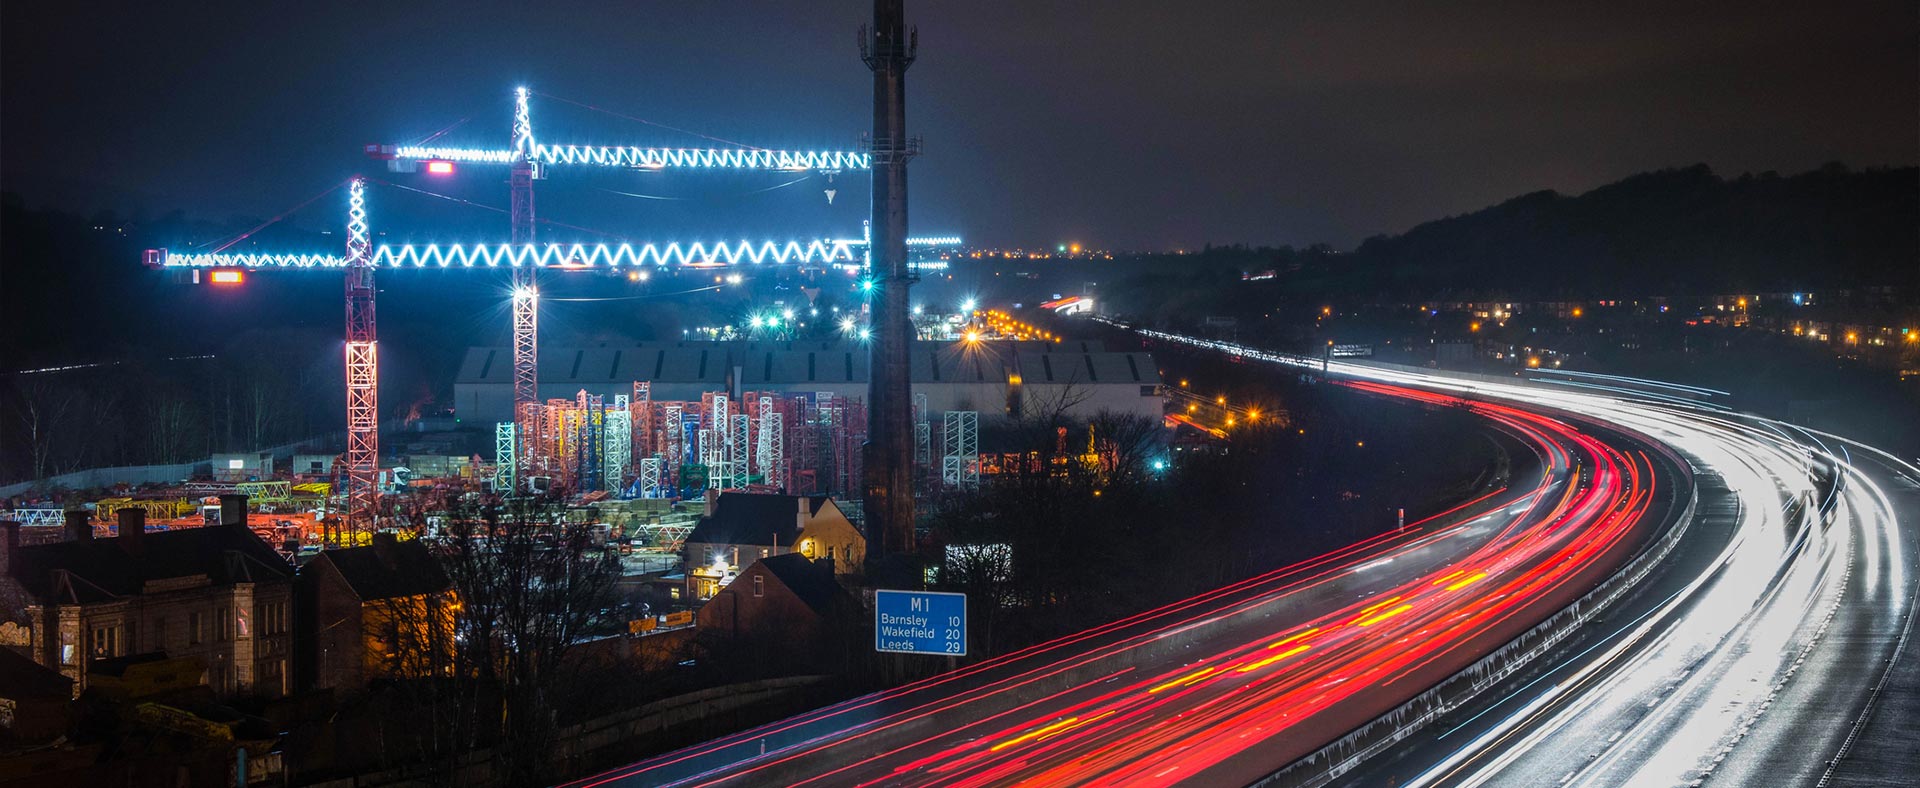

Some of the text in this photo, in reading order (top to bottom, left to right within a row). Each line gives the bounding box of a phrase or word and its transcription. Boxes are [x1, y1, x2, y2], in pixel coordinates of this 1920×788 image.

[881, 613, 960, 627] Barnsley 10
[881, 626, 960, 640] Wakefield 20
[881, 638, 960, 653] Leeds 29
